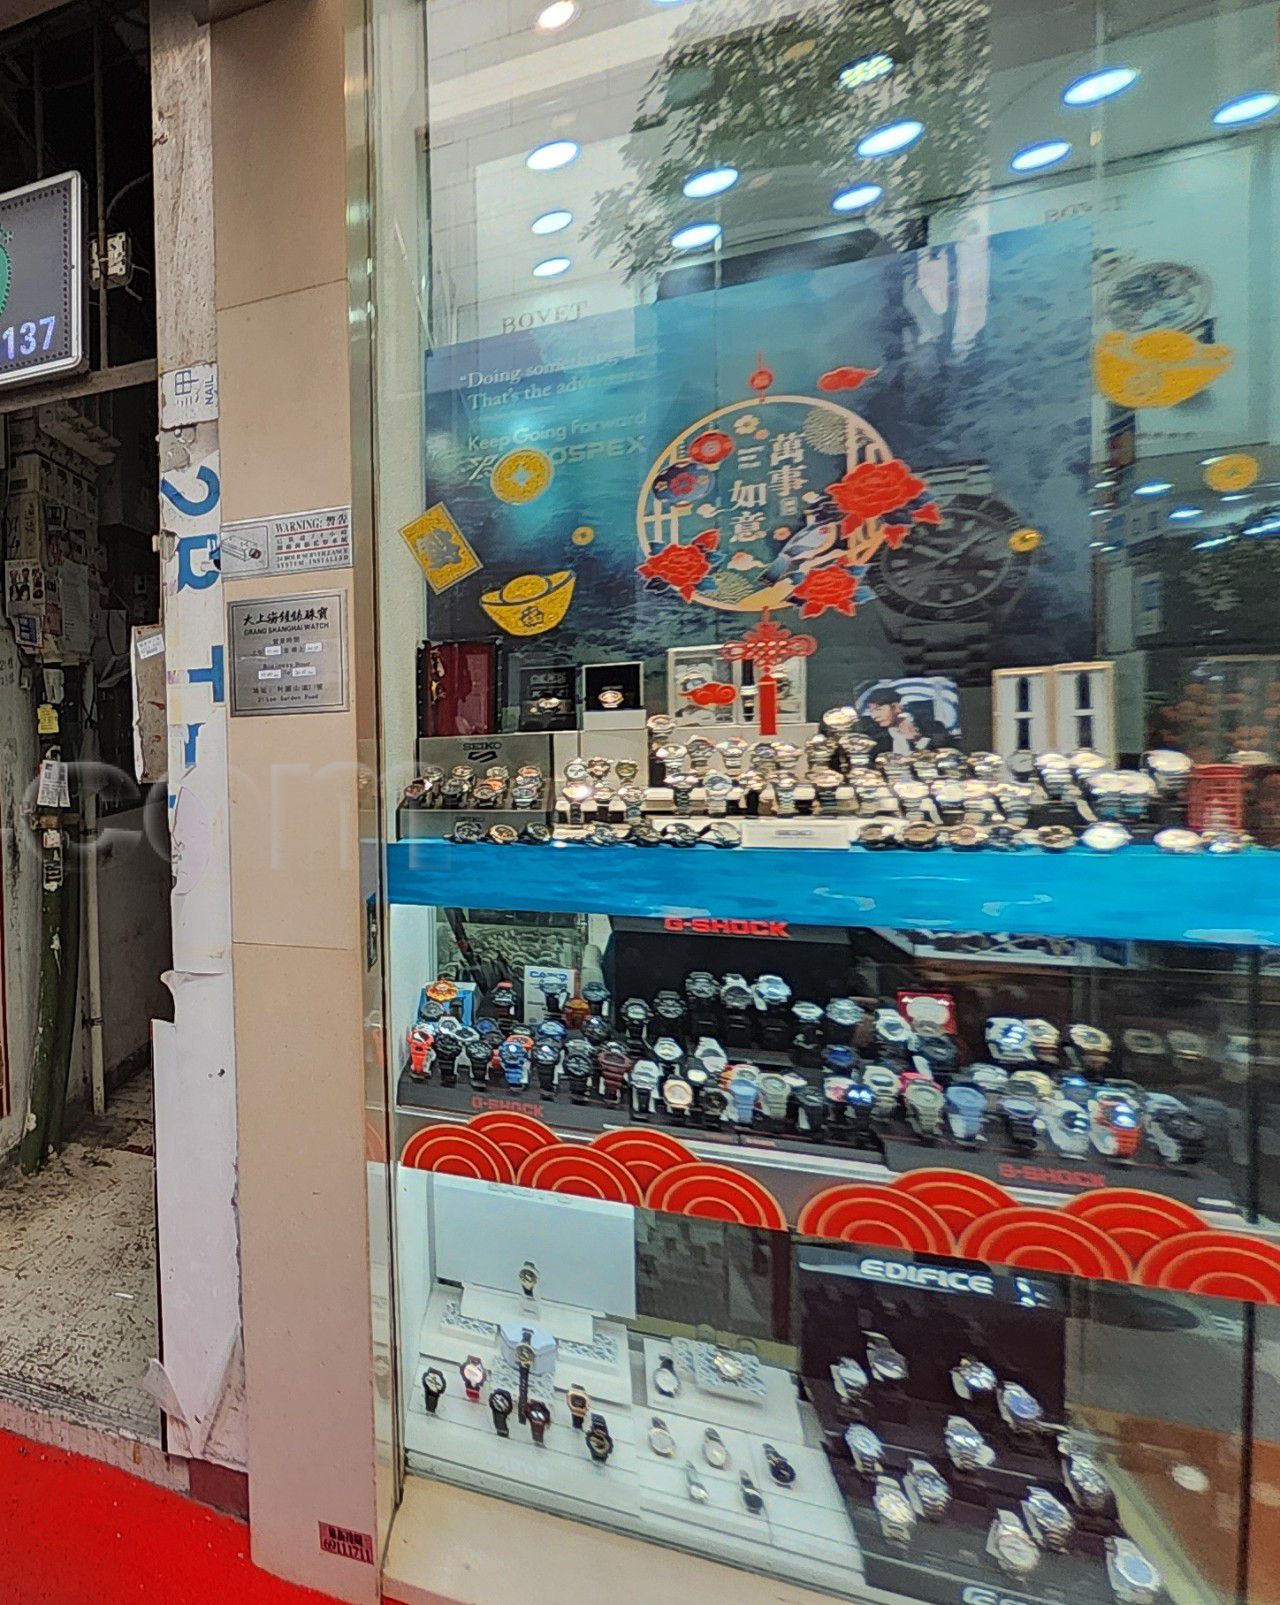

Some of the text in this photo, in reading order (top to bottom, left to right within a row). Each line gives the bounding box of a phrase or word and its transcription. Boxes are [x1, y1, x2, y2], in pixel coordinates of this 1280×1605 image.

[204, 374, 215, 405] NAIL
[524, 383, 551, 401] the
[467, 407, 648, 454] Keep Going Forward
[244, 621, 329, 637] GRAND SHANGHAI WATCH
[462, 741, 503, 752] SEIKO
[663, 916, 792, 940] G-SHOCK
[470, 1096, 546, 1118] G-SHOCK
[998, 1161, 1107, 1189] G-SHOCK
[859, 1257, 994, 1295] EDIFICE
